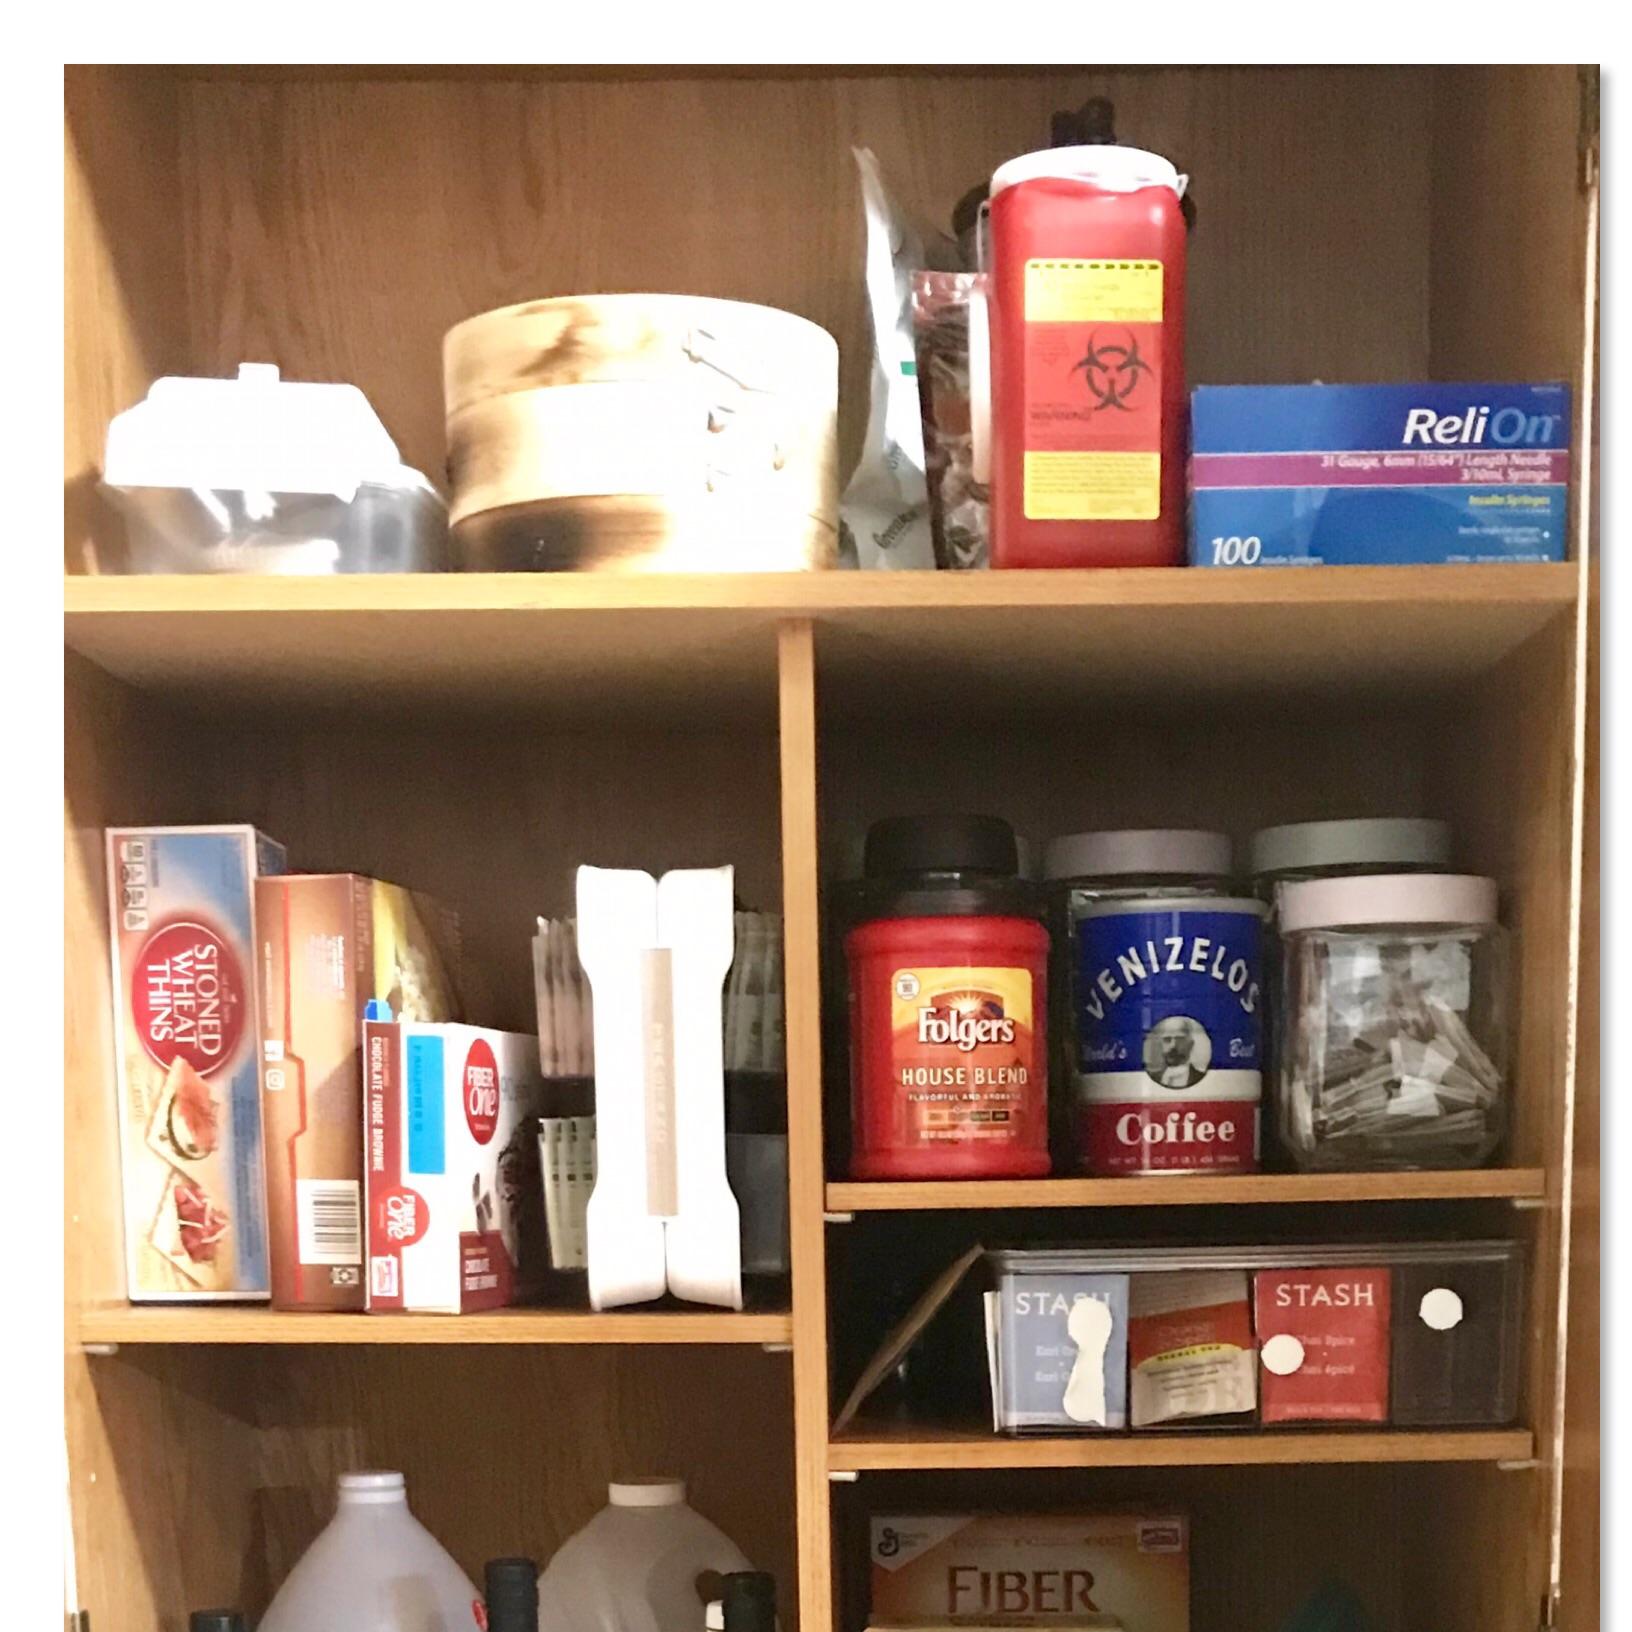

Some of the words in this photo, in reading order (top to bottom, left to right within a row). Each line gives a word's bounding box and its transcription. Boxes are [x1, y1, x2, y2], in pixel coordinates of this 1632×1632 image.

[1402, 406, 1554, 444] ReliOn
[1321, 453, 1335, 468] 31
[1466, 452, 1508, 471] Length
[1510, 452, 1552, 467] Needle
[1507, 469, 1552, 484] Syringe
[1211, 535, 1262, 566] 100
[1085, 936, 1260, 1021] VENIZELOS
[147, 959, 175, 1042] THINS
[171, 949, 198, 1049] WHEAT
[194, 943, 222, 1056] STONED
[917, 1006, 1015, 1052] Folgers
[371, 1036, 384, 1091] CHOCOLATE
[467, 1065, 495, 1088] FIBER
[902, 1067, 966, 1086] HOUSE
[974, 1066, 1028, 1085] BLEND
[372, 1092, 384, 1125] FUDGE
[469, 1085, 497, 1118] One
[1115, 1111, 1236, 1147] Coffee
[373, 1127, 385, 1173] BROWNIE
[386, 1195, 409, 1241] One
[402, 1194, 417, 1236] FIBER
[1015, 1291, 1112, 1316] STA
[1275, 1282, 1375, 1307] STASH
[947, 1565, 1100, 1613] FIBER
